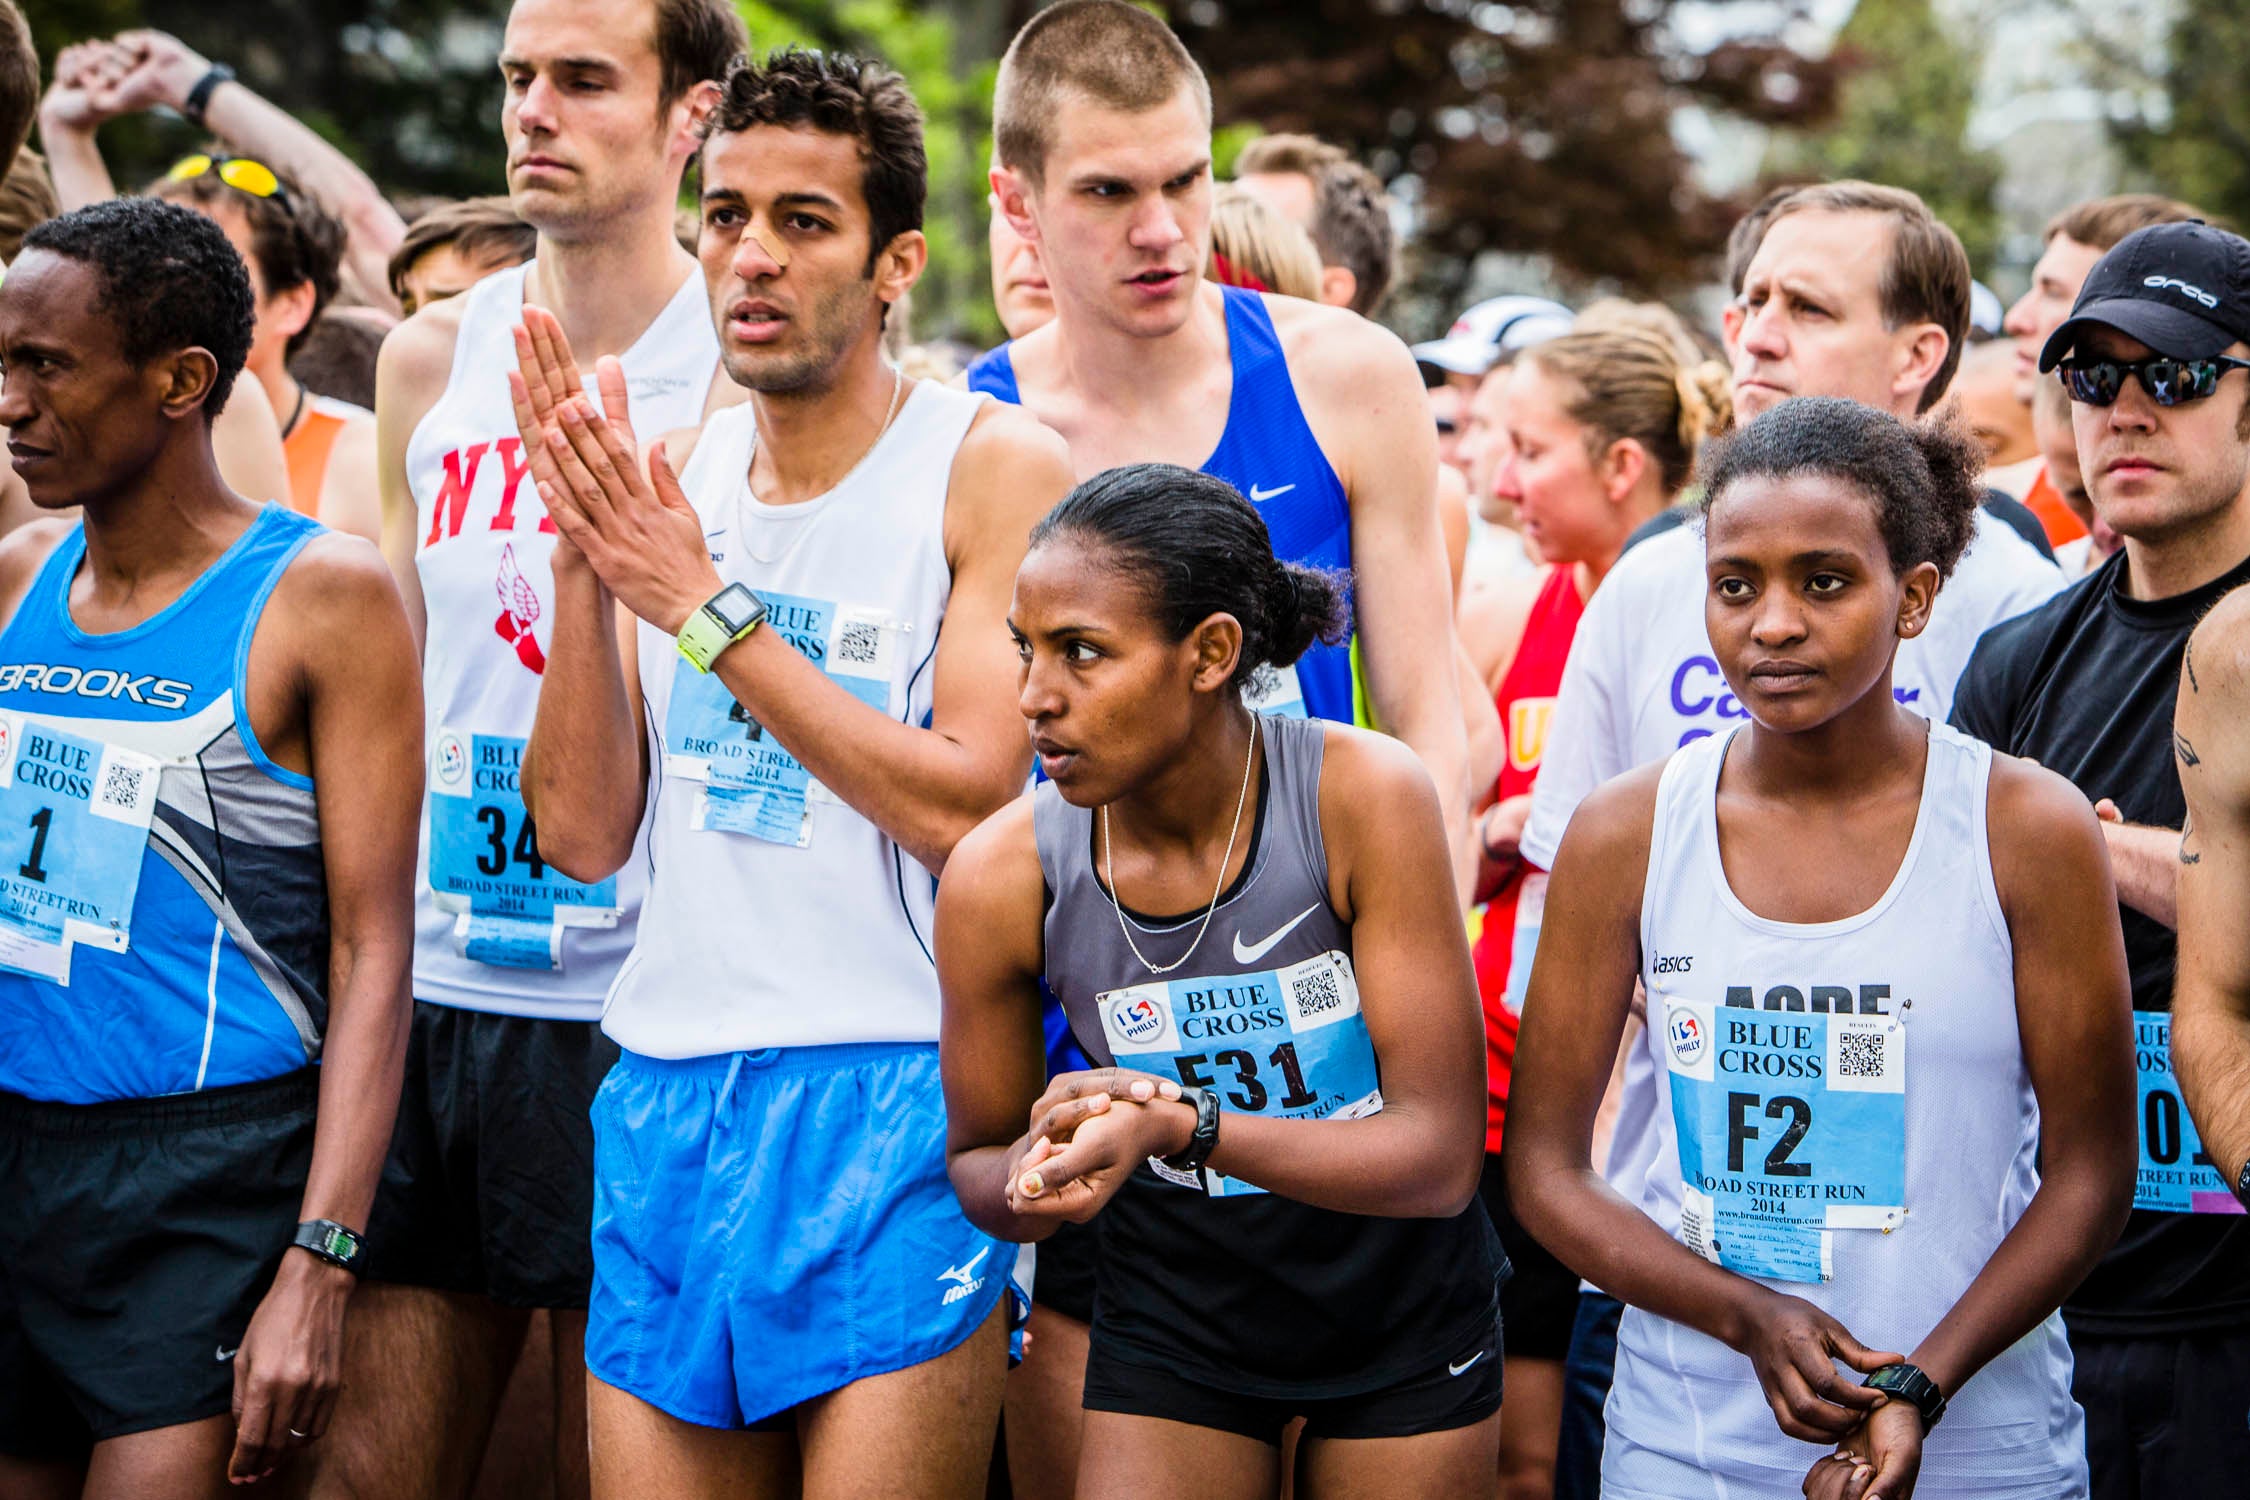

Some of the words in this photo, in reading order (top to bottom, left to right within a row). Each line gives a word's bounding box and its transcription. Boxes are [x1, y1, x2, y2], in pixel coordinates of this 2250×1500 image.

[2143, 275, 2218, 309] orca
[0, 664, 192, 710] BROOKS
[29, 735, 91, 772] BLUE
[684, 737, 742, 758] BROAD
[17, 760, 92, 800] CROSS
[475, 768, 521, 793] CRO
[747, 763, 780, 781] 2014
[19, 806, 54, 884] 1
[11, 883, 66, 909] STREET
[66, 898, 101, 919] RUN
[448, 876, 491, 893] BROAD
[495, 882, 549, 900] STREET
[553, 888, 586, 901] RUN
[11, 898, 37, 917] 2014
[499, 897, 525, 911] 2014
[1658, 956, 1694, 973] asics
[1186, 984, 1270, 1014] BLUE
[1126, 1018, 1159, 1038] PHILLY
[1182, 1007, 1285, 1039] CROSS
[1727, 1020, 1813, 1050] BLUE
[1676, 1039, 1700, 1054] PHILLY
[1718, 1049, 1823, 1079] CROSS
[1727, 1091, 1812, 1177] F2
[2138, 1169, 2185, 1185] TREET
[1747, 1181, 1823, 1199] STREET
[1825, 1184, 1866, 1199] RUN
[1718, 1209, 1823, 1225] www.broadstreetrun.com
[1751, 1198, 1785, 1214] 2014
[1817, 1273, 1830, 1281] 202
